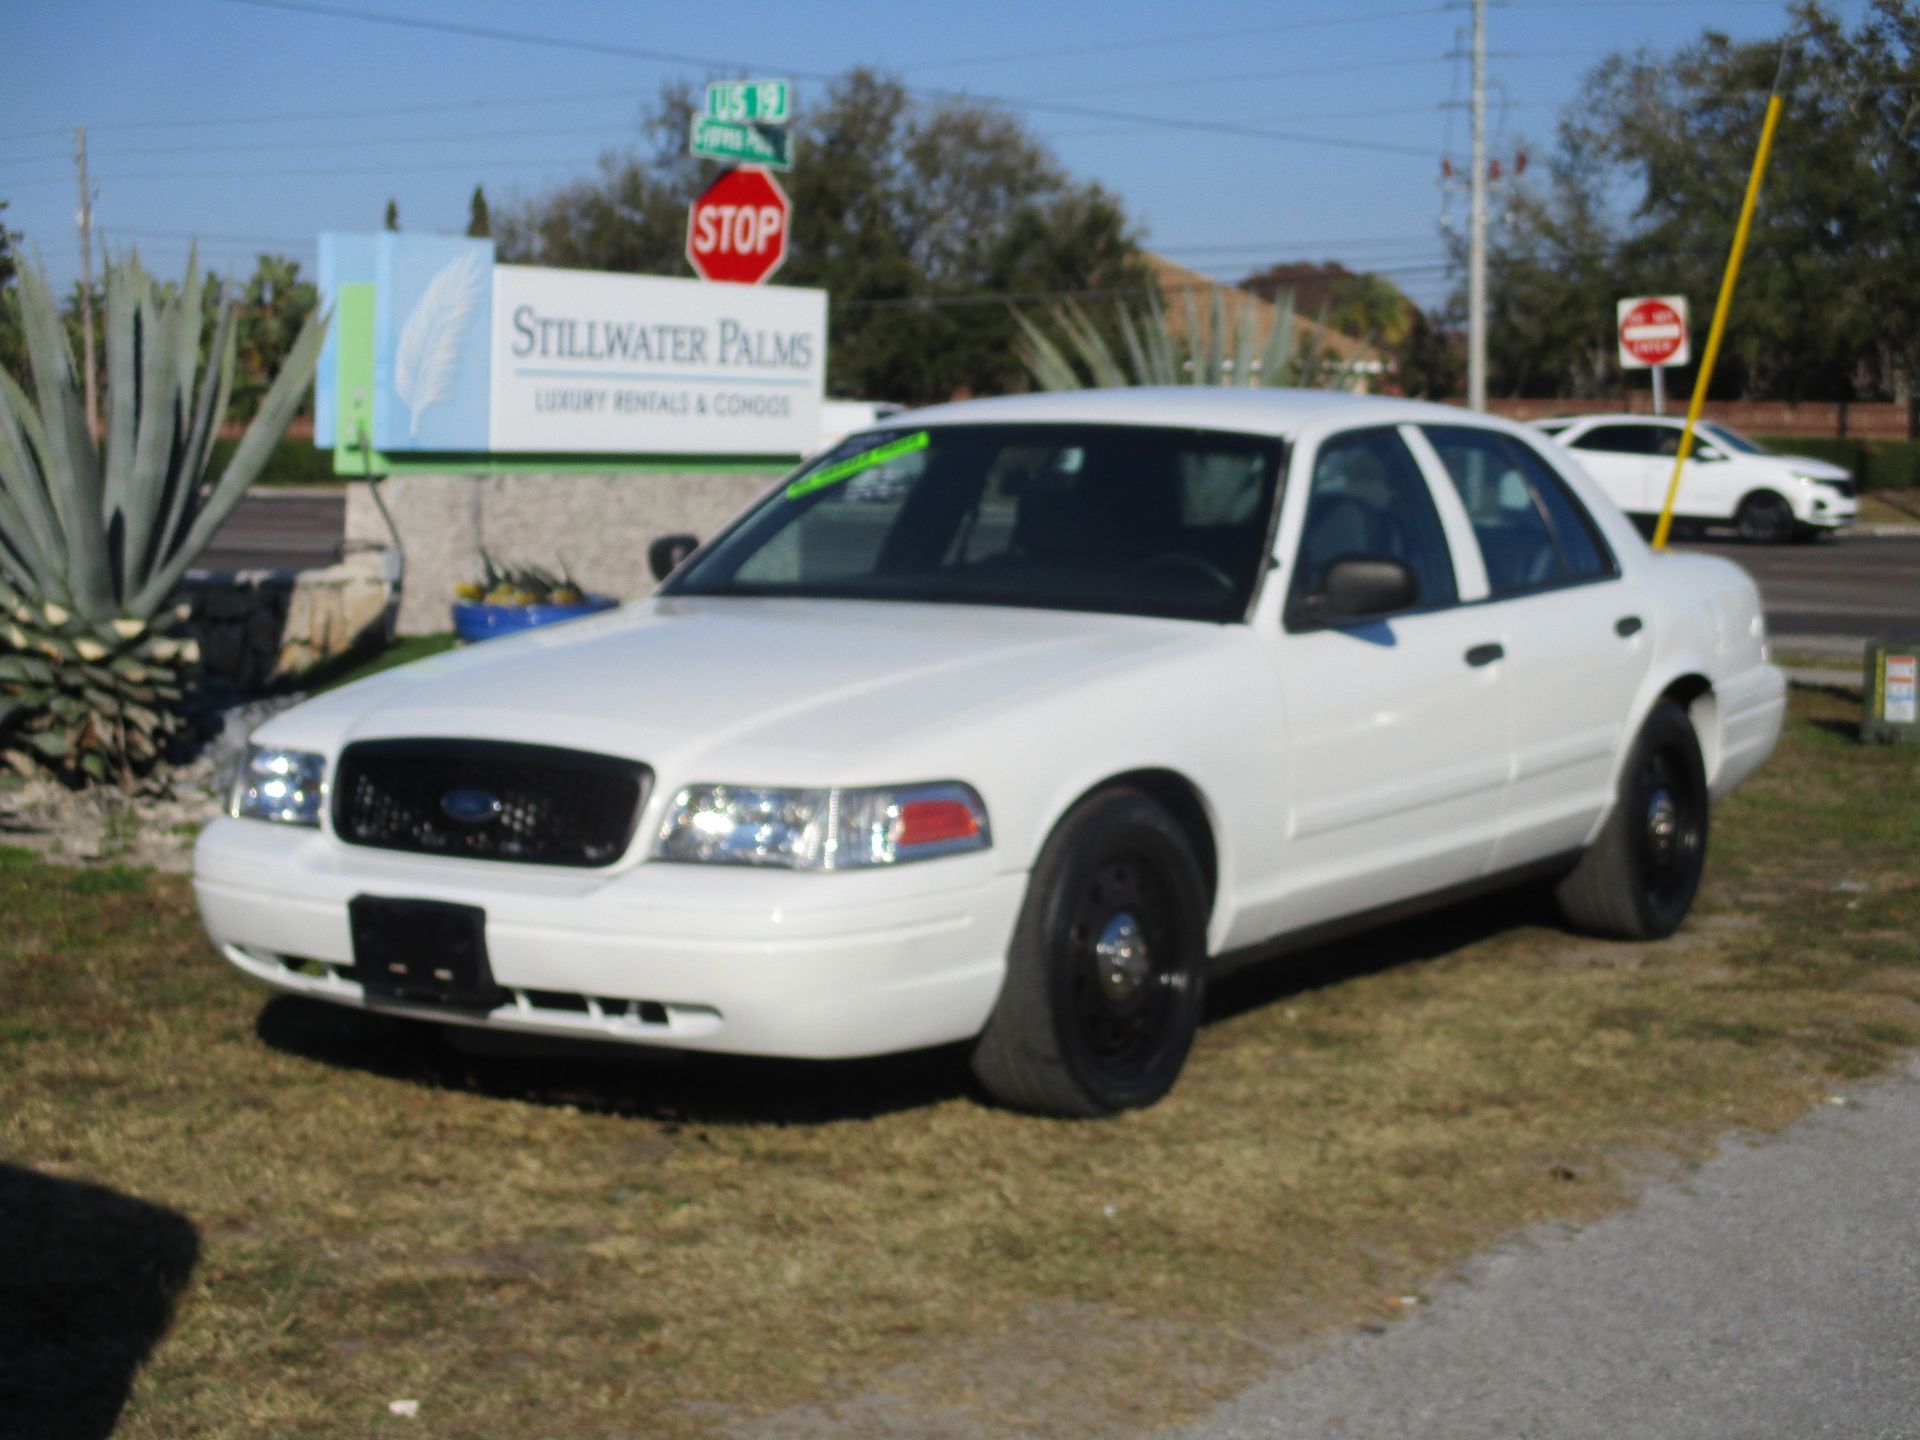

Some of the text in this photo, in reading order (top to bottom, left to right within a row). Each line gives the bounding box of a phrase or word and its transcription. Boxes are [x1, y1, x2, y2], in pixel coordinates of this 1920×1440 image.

[716, 83, 779, 119] US 19
[695, 205, 781, 253] STOP
[512, 304, 812, 368] STILLWATER PALMS
[534, 388, 790, 417] LUXURY RENTALS & CONDOS
